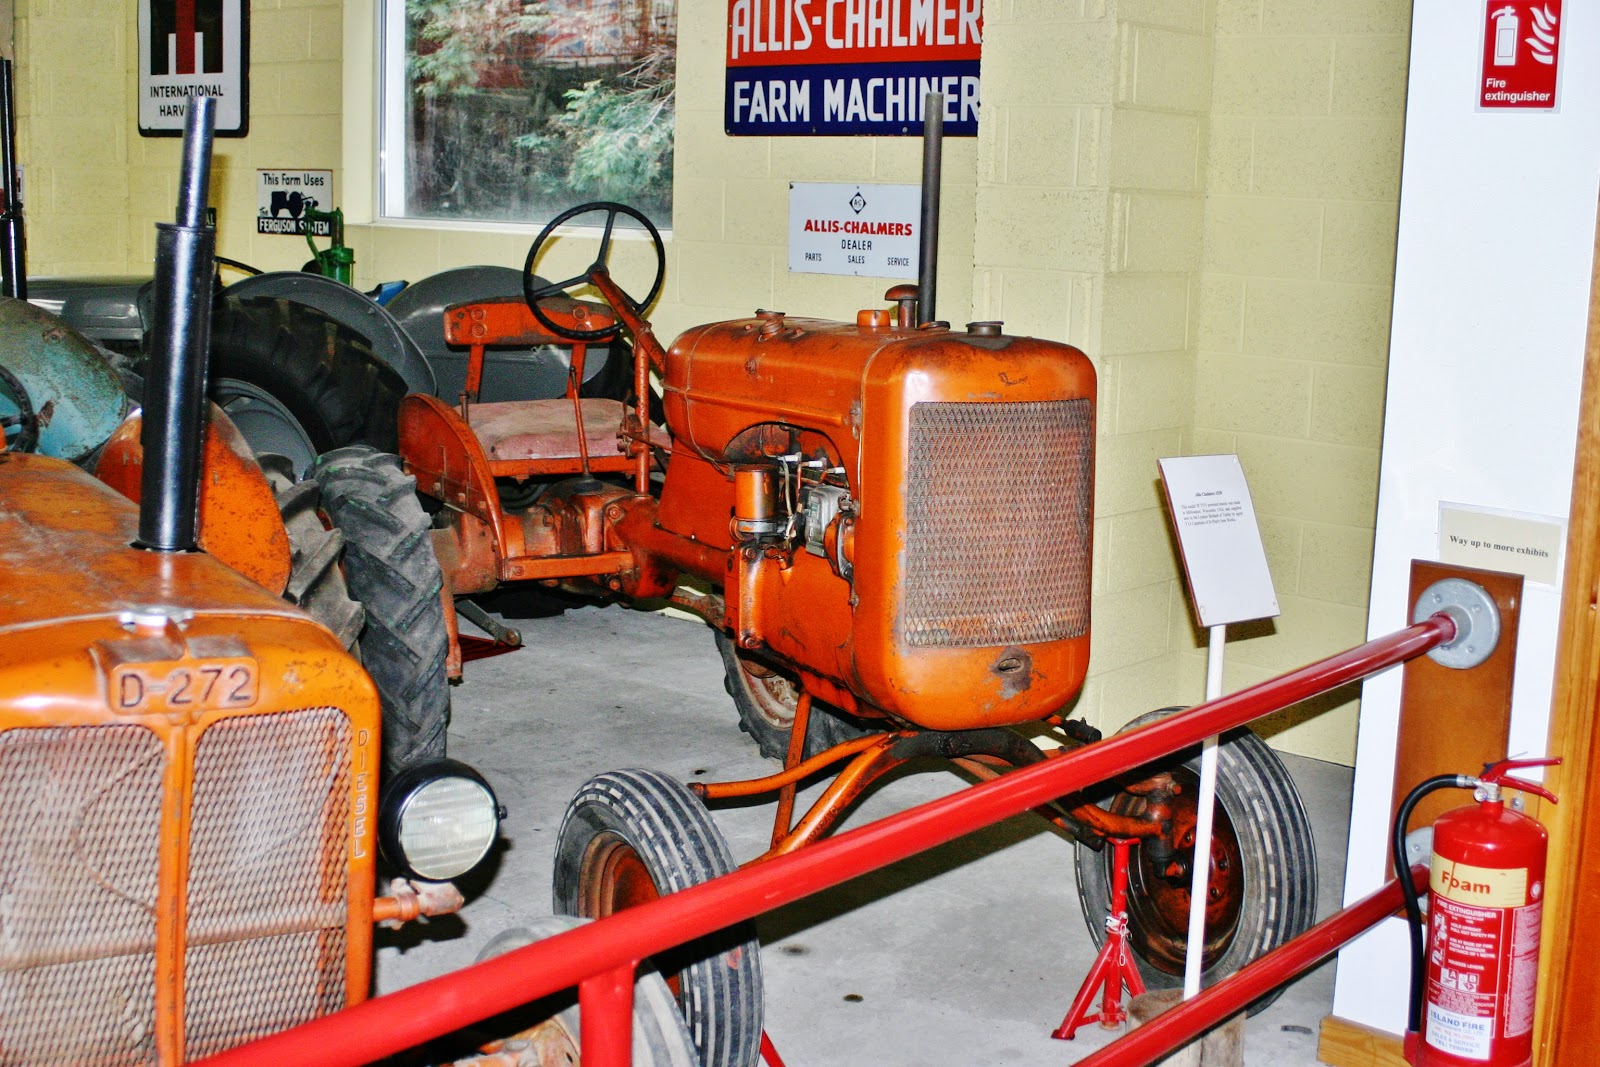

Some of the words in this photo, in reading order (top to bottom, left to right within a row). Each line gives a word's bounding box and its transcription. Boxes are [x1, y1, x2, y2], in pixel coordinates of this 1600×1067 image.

[731, 0, 981, 59] ALLIS-CHALMER
[1486, 78, 1506, 88] Fire
[150, 85, 223, 98] INTERNATIONAL
[733, 80, 810, 122] FARM
[823, 76, 980, 122] MACHINER
[1485, 91, 1550, 103] extinguisher
[263, 173, 279, 185] This
[281, 173, 301, 186] Farm
[303, 173, 324, 186] Uses
[259, 219, 296, 233] FERGUSON
[804, 219, 912, 236] ALLIS-CHALMERS
[841, 239, 872, 251] DEALER
[805, 252, 822, 262] PARTS
[847, 255, 865, 264] SALES
[887, 257, 909, 266] SERVICE
[1449, 535, 1468, 546] Way
[1470, 540, 1481, 549] up
[1483, 541, 1491, 549] to
[1493, 543, 1515, 553] more
[1516, 546, 1549, 558] exhibits
[120, 666, 251, 708] D-272
[353, 729, 369, 858] DIESEL
[1441, 870, 1490, 895] Foam
[1449, 904, 1496, 918] EXTINGUISHER
[1430, 1010, 1460, 1027] ISLAND
[1462, 1021, 1485, 1031] FIRE
